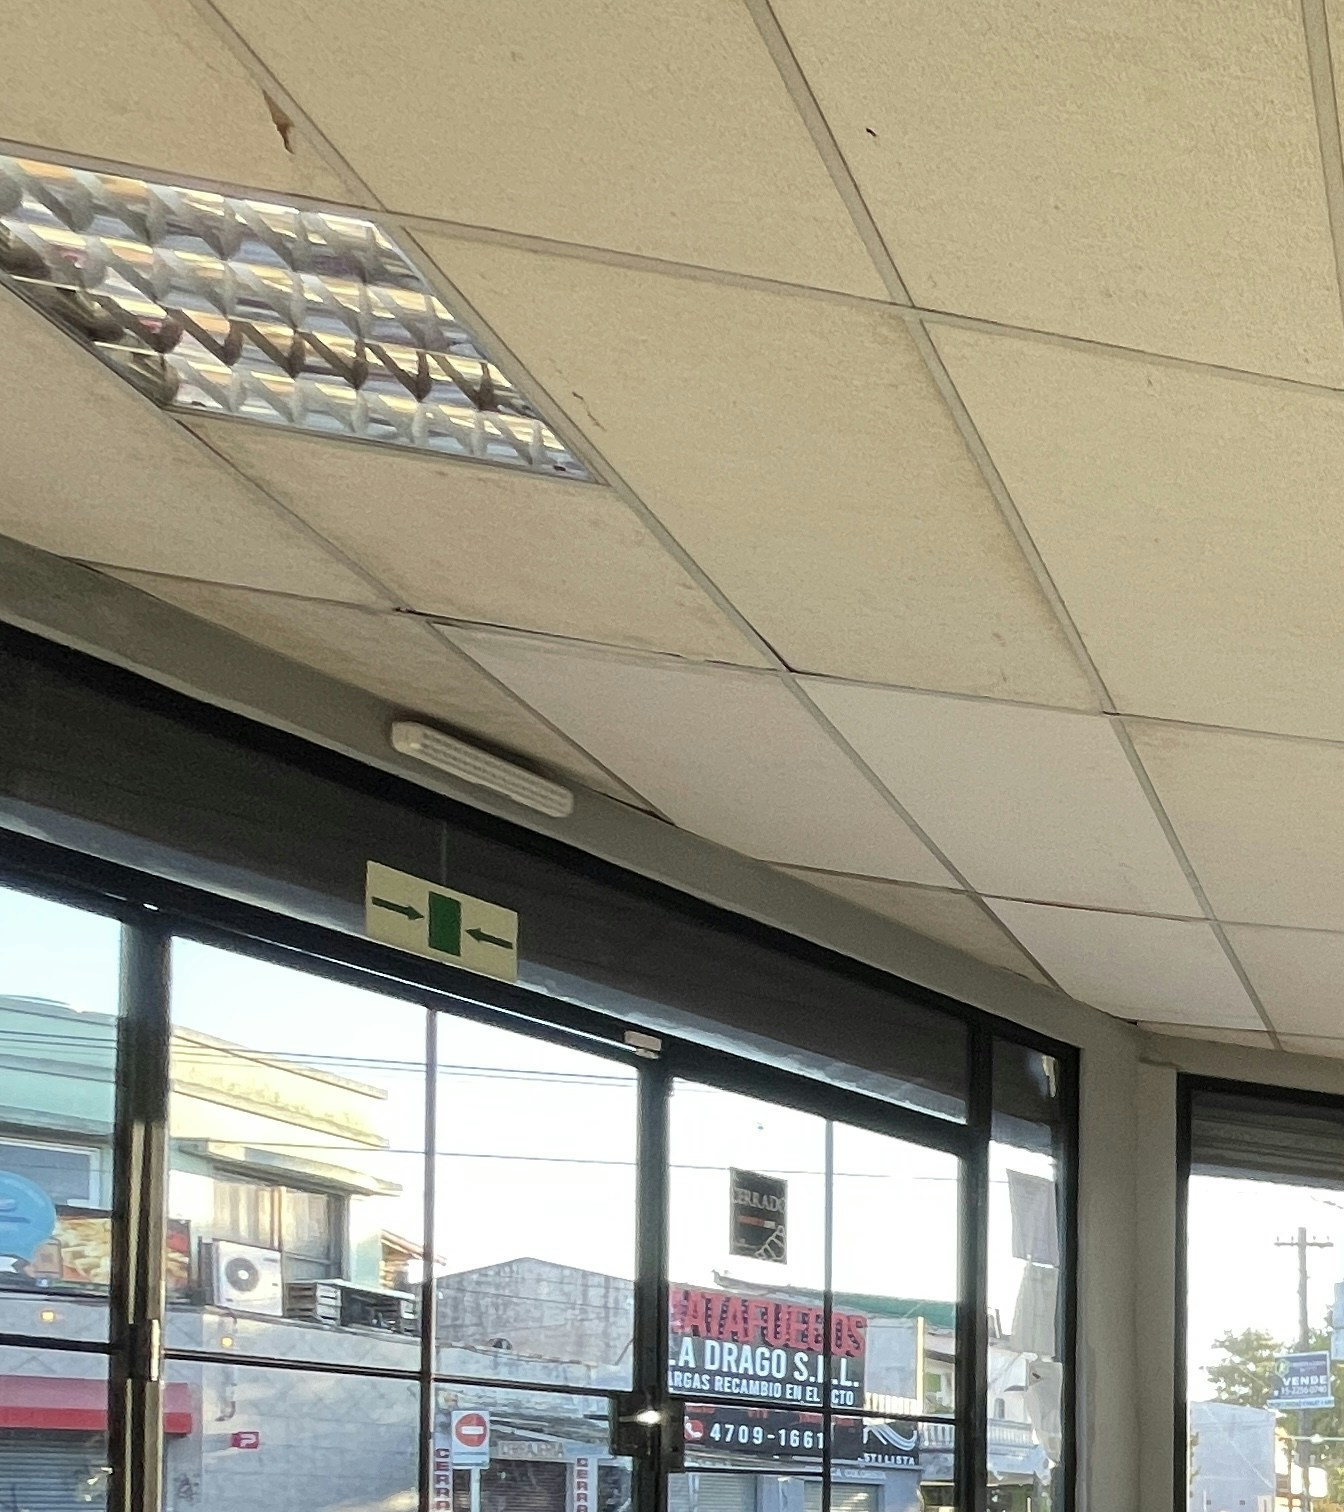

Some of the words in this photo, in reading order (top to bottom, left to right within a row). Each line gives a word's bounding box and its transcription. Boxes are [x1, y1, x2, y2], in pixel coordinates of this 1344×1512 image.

[668, 1337, 696, 1369] A
[704, 1340, 787, 1379] DRAGO
[714, 1375, 782, 1399] RECAMBIO
[785, 1384, 801, 1401] EN
[806, 1388, 821, 1402] EL
